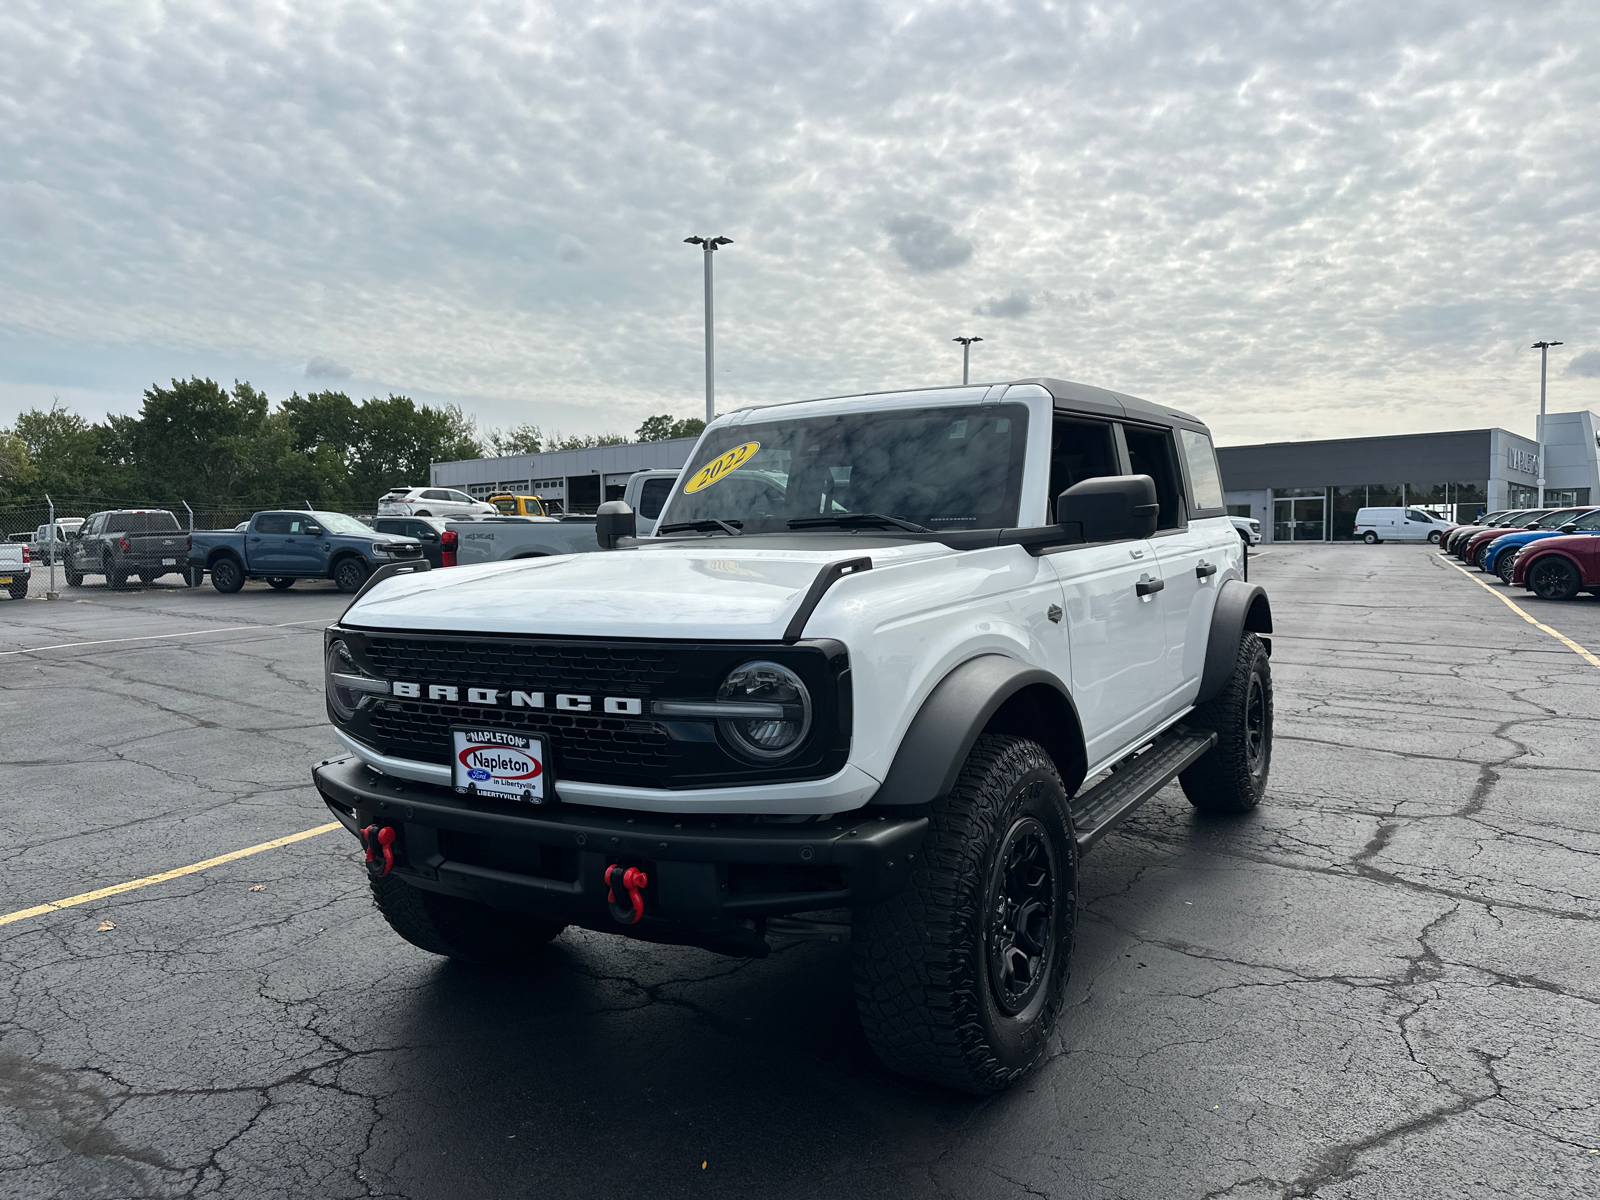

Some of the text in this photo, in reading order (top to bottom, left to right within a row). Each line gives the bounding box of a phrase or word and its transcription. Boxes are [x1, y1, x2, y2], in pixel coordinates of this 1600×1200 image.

[697, 446, 748, 488] 2022
[392, 681, 642, 715] BRONCO
[470, 731, 522, 747] NAPLETON
[472, 751, 529, 773] Napleton
[471, 770, 488, 780] Ford
[501, 780, 536, 790] Libertyville
[476, 789, 521, 801] LIBERTYVILLE
